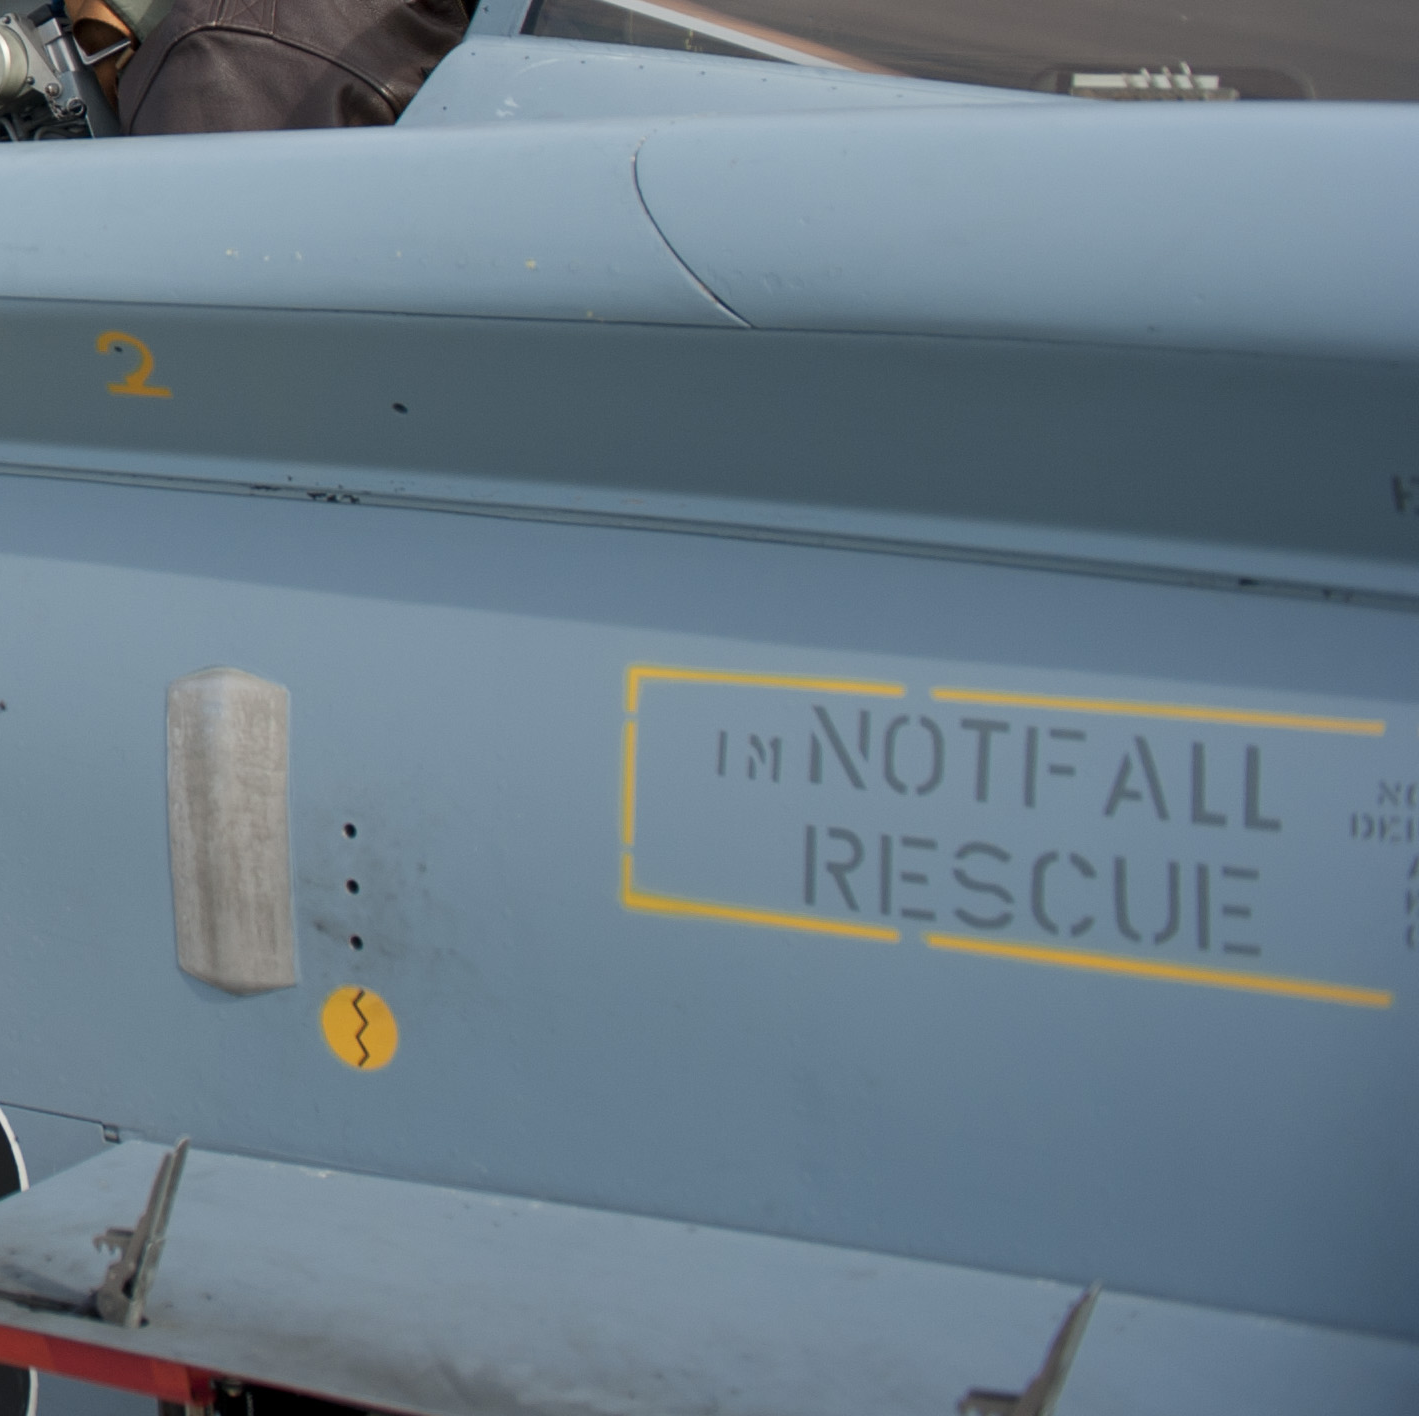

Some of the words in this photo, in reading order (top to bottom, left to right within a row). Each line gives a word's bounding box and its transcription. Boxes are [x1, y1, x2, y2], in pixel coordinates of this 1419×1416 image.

[95, 330, 173, 399] 2
[807, 705, 1283, 833] NOTFALL
[802, 824, 1263, 957] RESCUE
